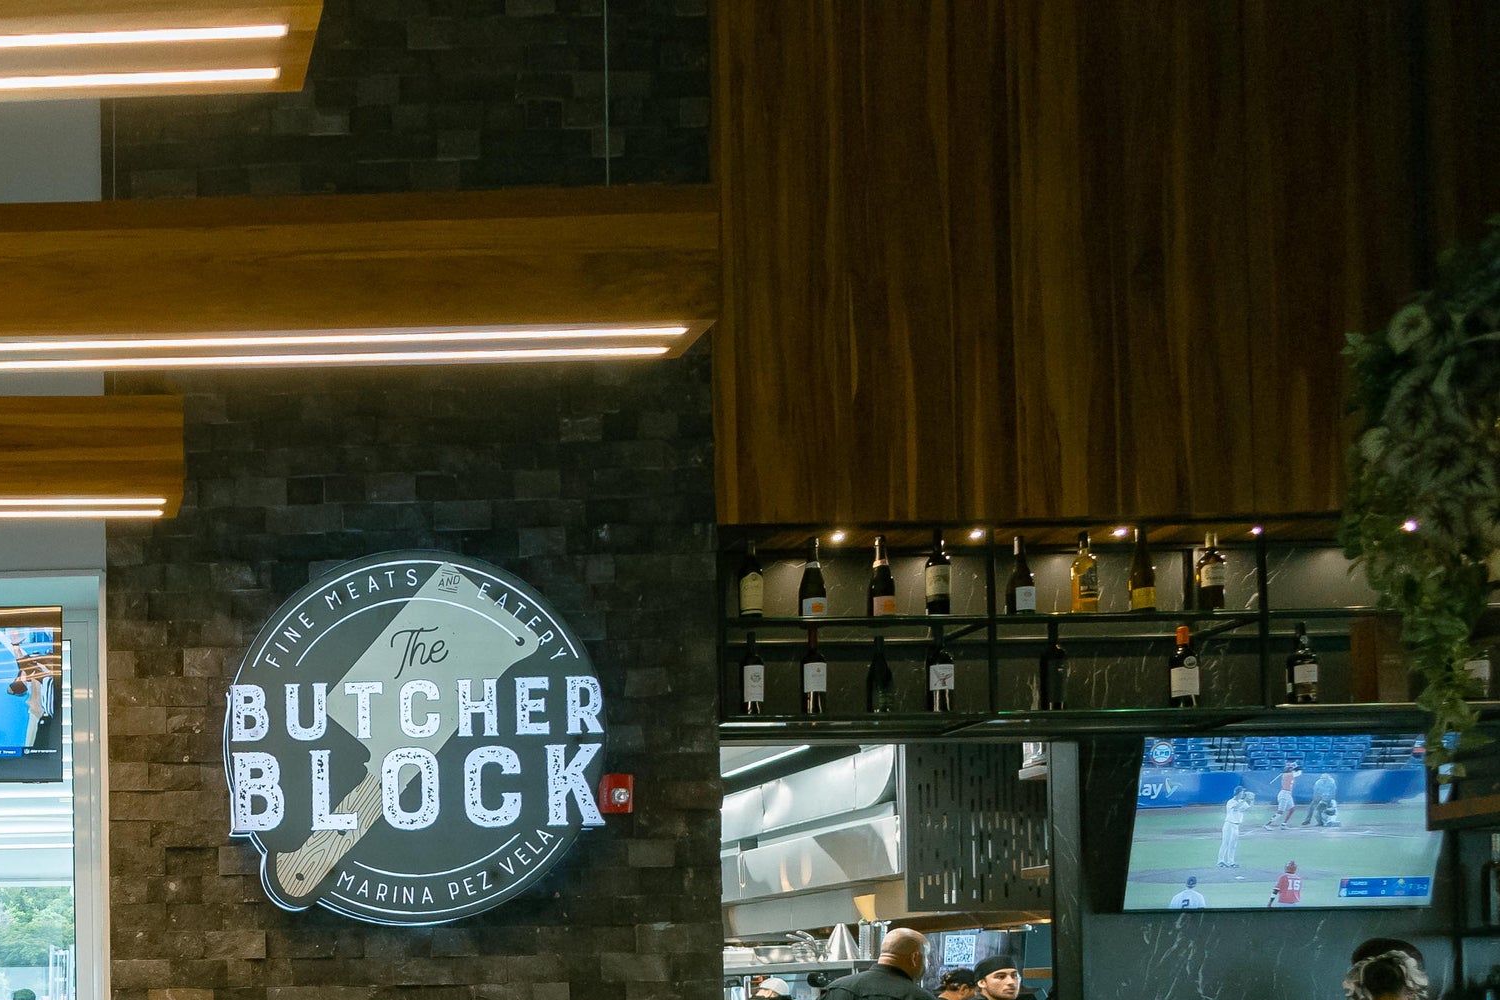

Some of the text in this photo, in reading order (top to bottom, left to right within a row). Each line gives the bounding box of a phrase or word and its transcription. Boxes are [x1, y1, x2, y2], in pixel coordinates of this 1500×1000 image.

[265, 568, 568, 668] FINE MEATS AND EATERY
[390, 626, 449, 679] The
[230, 676, 605, 742] BUTCHER
[232, 743, 606, 832] BLOCK
[336, 828, 554, 905] MARINA PEZ VELA
